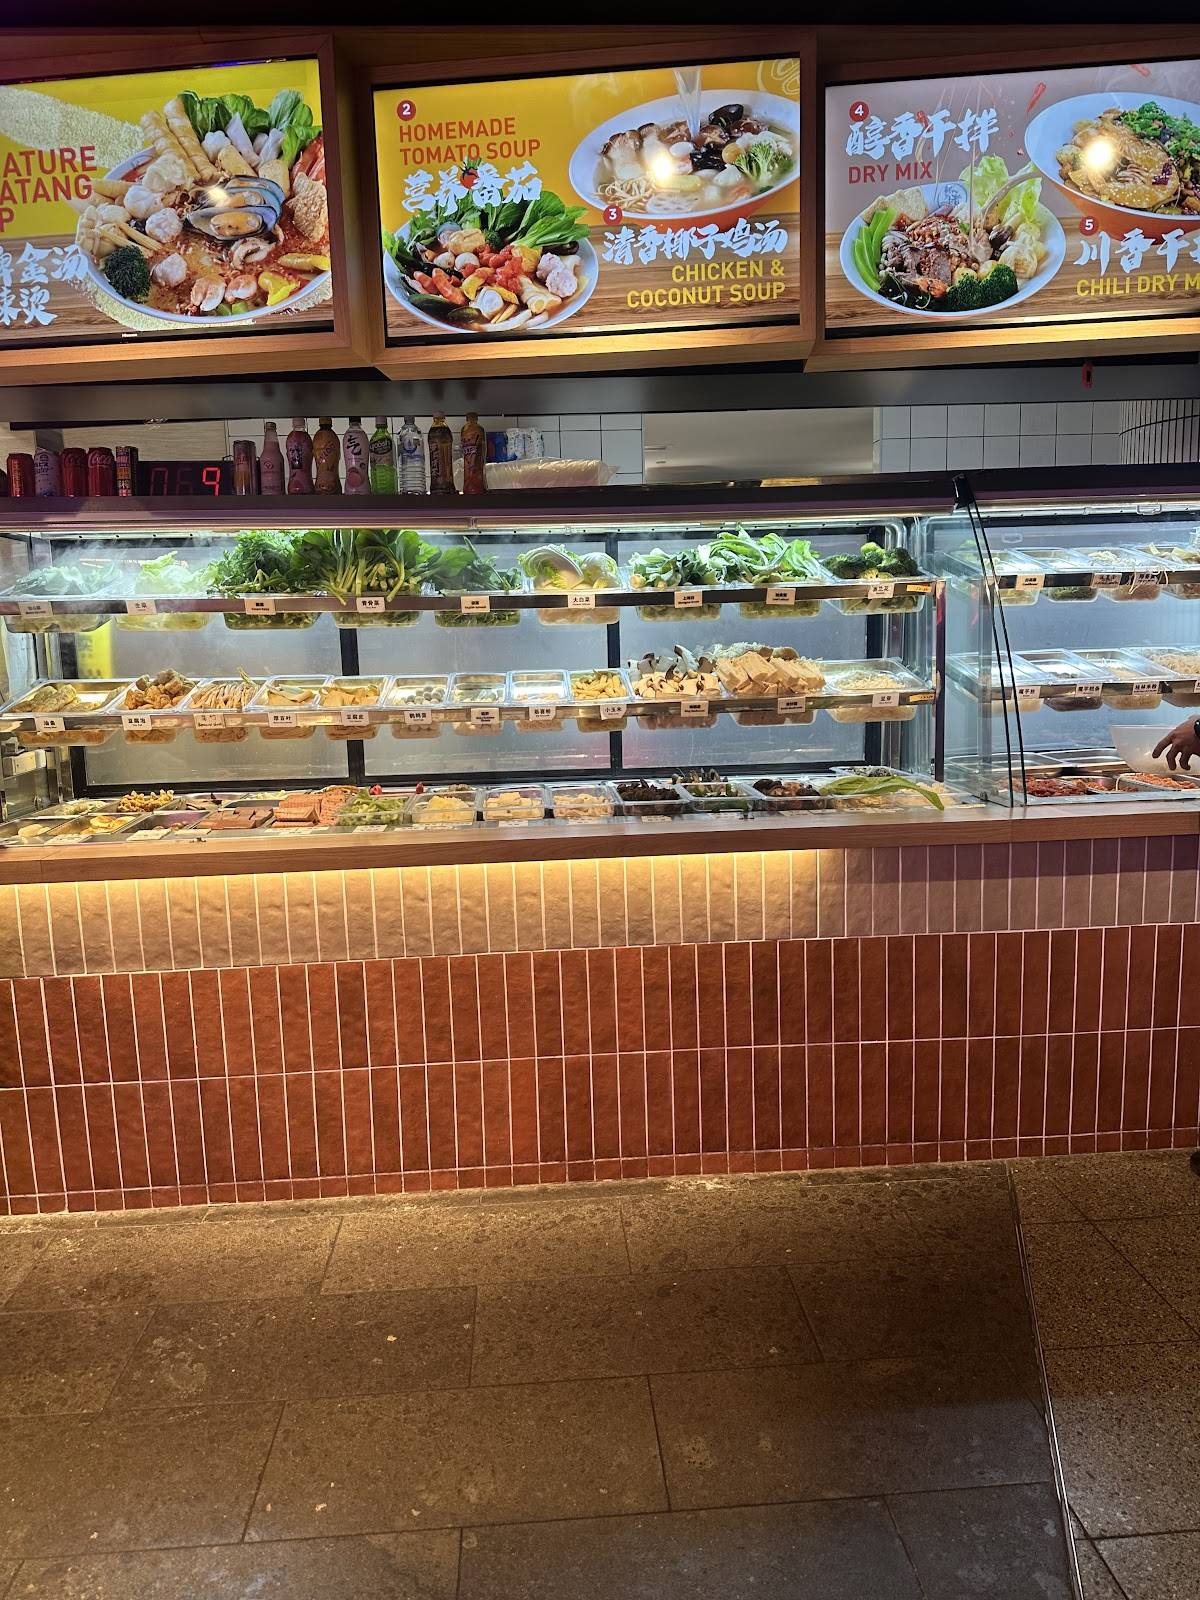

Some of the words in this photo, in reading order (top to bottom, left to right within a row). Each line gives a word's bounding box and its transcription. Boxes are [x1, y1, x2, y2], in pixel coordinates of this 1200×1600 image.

[402, 103, 411, 116] 2
[854, 104, 864, 117] 4
[400, 117, 516, 143] HOMEMADE
[846, 108, 999, 161] 醇香干拌
[3, 146, 97, 177] ATURE
[400, 143, 480, 166] TOMATO
[486, 138, 541, 160] SOUP
[848, 164, 889, 184] DRY
[895, 160, 933, 181] MIX
[0, 174, 92, 205] ATANG
[402, 160, 543, 216] 营养番茄
[608, 208, 617, 221] 3
[1084, 218, 1094, 231] 5
[602, 217, 788, 265] 清香椰子鸡汤
[671, 259, 764, 283] CHICKEN
[770, 258, 785, 277] &
[627, 285, 724, 308] COCONUT
[729, 281, 786, 302] SOUP
[1077, 276, 1130, 296] CHILI
[1137, 273, 1180, 293] DRY
